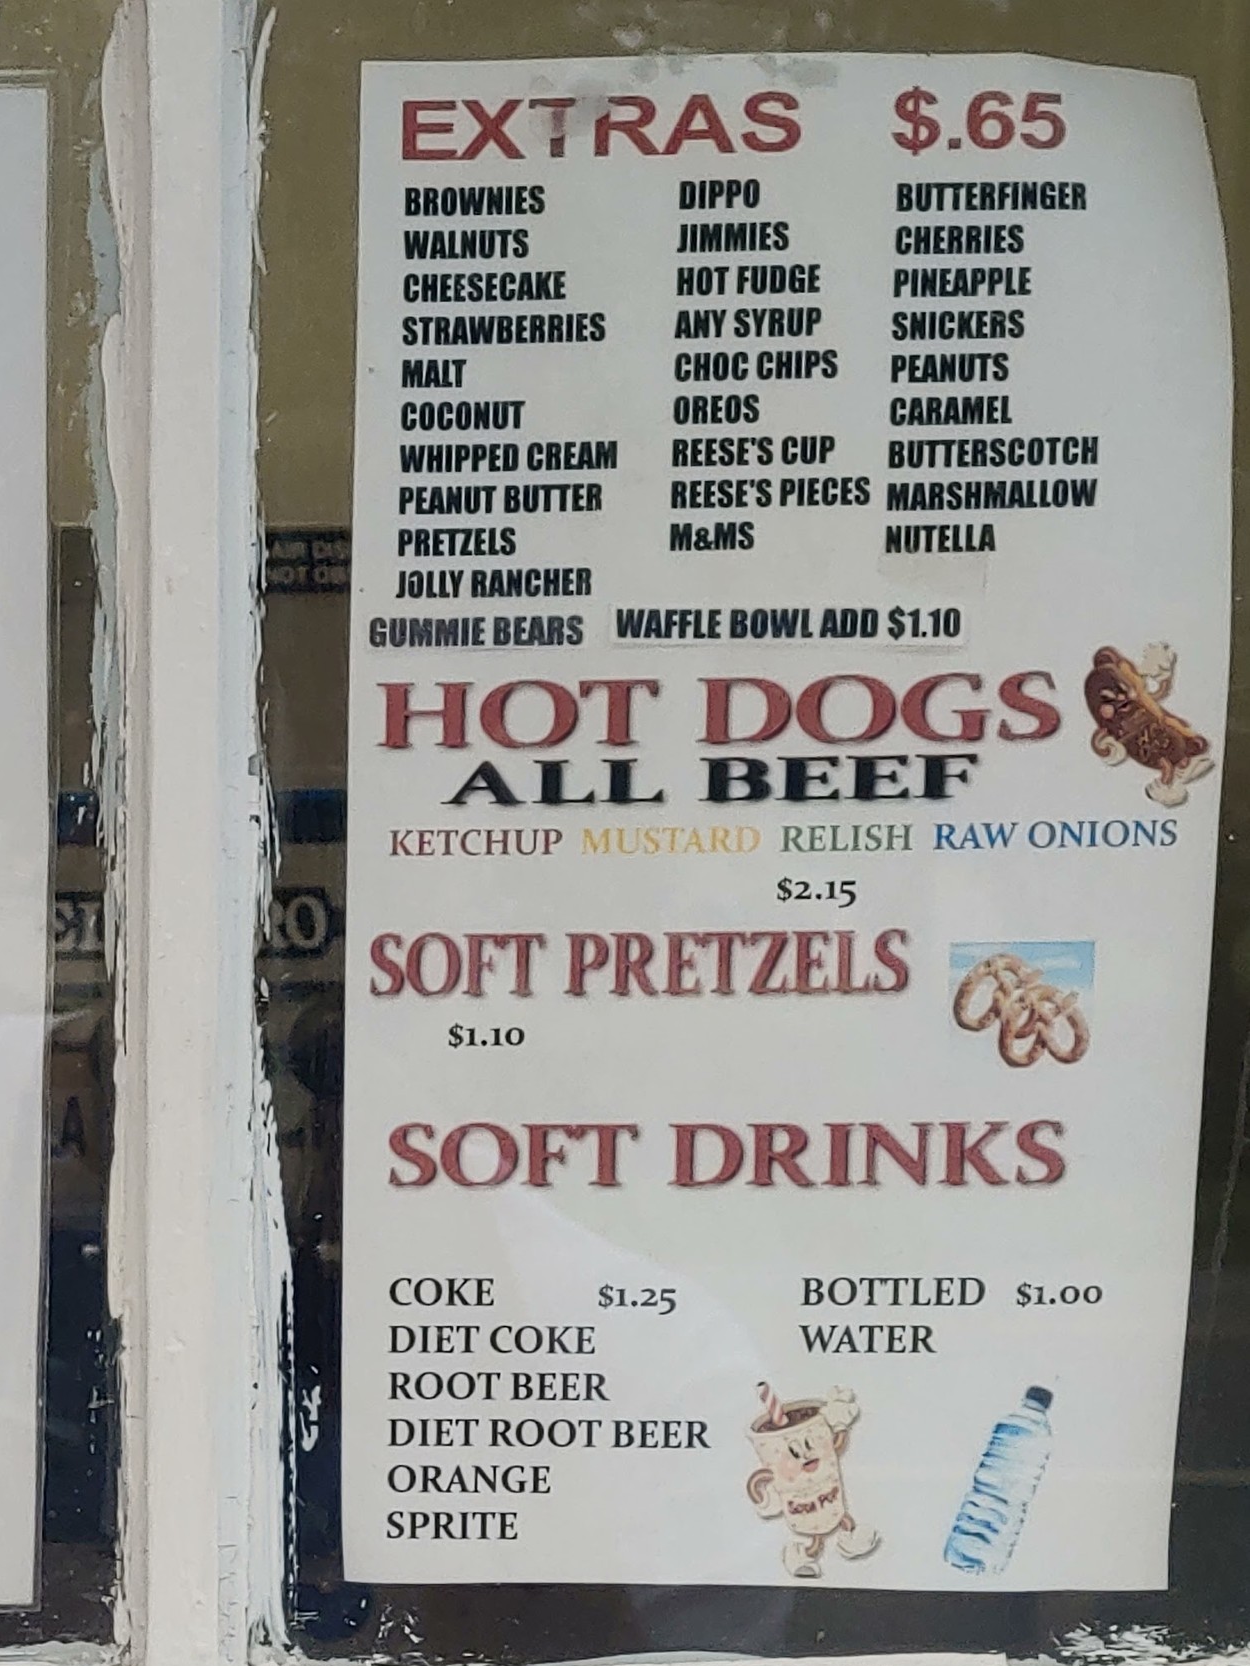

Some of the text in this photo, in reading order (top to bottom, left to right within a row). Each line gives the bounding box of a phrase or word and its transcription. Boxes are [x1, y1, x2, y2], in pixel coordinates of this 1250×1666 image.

[402, 86, 1066, 161] EXTRAS $.65
[404, 229, 529, 259] WALNUTS
[403, 271, 566, 303] CHEESECAKE
[894, 267, 1031, 297] PINEAPPLE
[402, 312, 605, 346] STRAWBERRIES
[892, 310, 1024, 341] SNICKERS
[675, 349, 838, 382] CHOC CHIPS
[674, 394, 759, 425] OREOS
[672, 436, 835, 467] REESE'S CUP
[399, 483, 602, 515] PEANUT BUTTER
[398, 527, 516, 556] PRETZELS
[886, 524, 995, 554] NUTELLA
[369, 615, 583, 647] GUMMIE BEARS
[376, 671, 1062, 751] HOT DOGS
[441, 754, 978, 807] ALL BEEF
[390, 819, 1177, 856] KETCHUP MUSTARD RELISH RAW ONIONS
[777, 877, 856, 908] $2.15
[370, 929, 910, 999] SOFT PRETZELS
[449, 1023, 524, 1048] $1.10
[389, 1120, 1066, 1189] SOFT DRINKS
[389, 1278, 676, 1315] COKE $1.25
[801, 1277, 1102, 1307] BOTTLED $1.00
[389, 1325, 595, 1354] DIET COKE
[799, 1325, 936, 1353] WATER
[388, 1419, 711, 1448] DIET ROOT BEER
